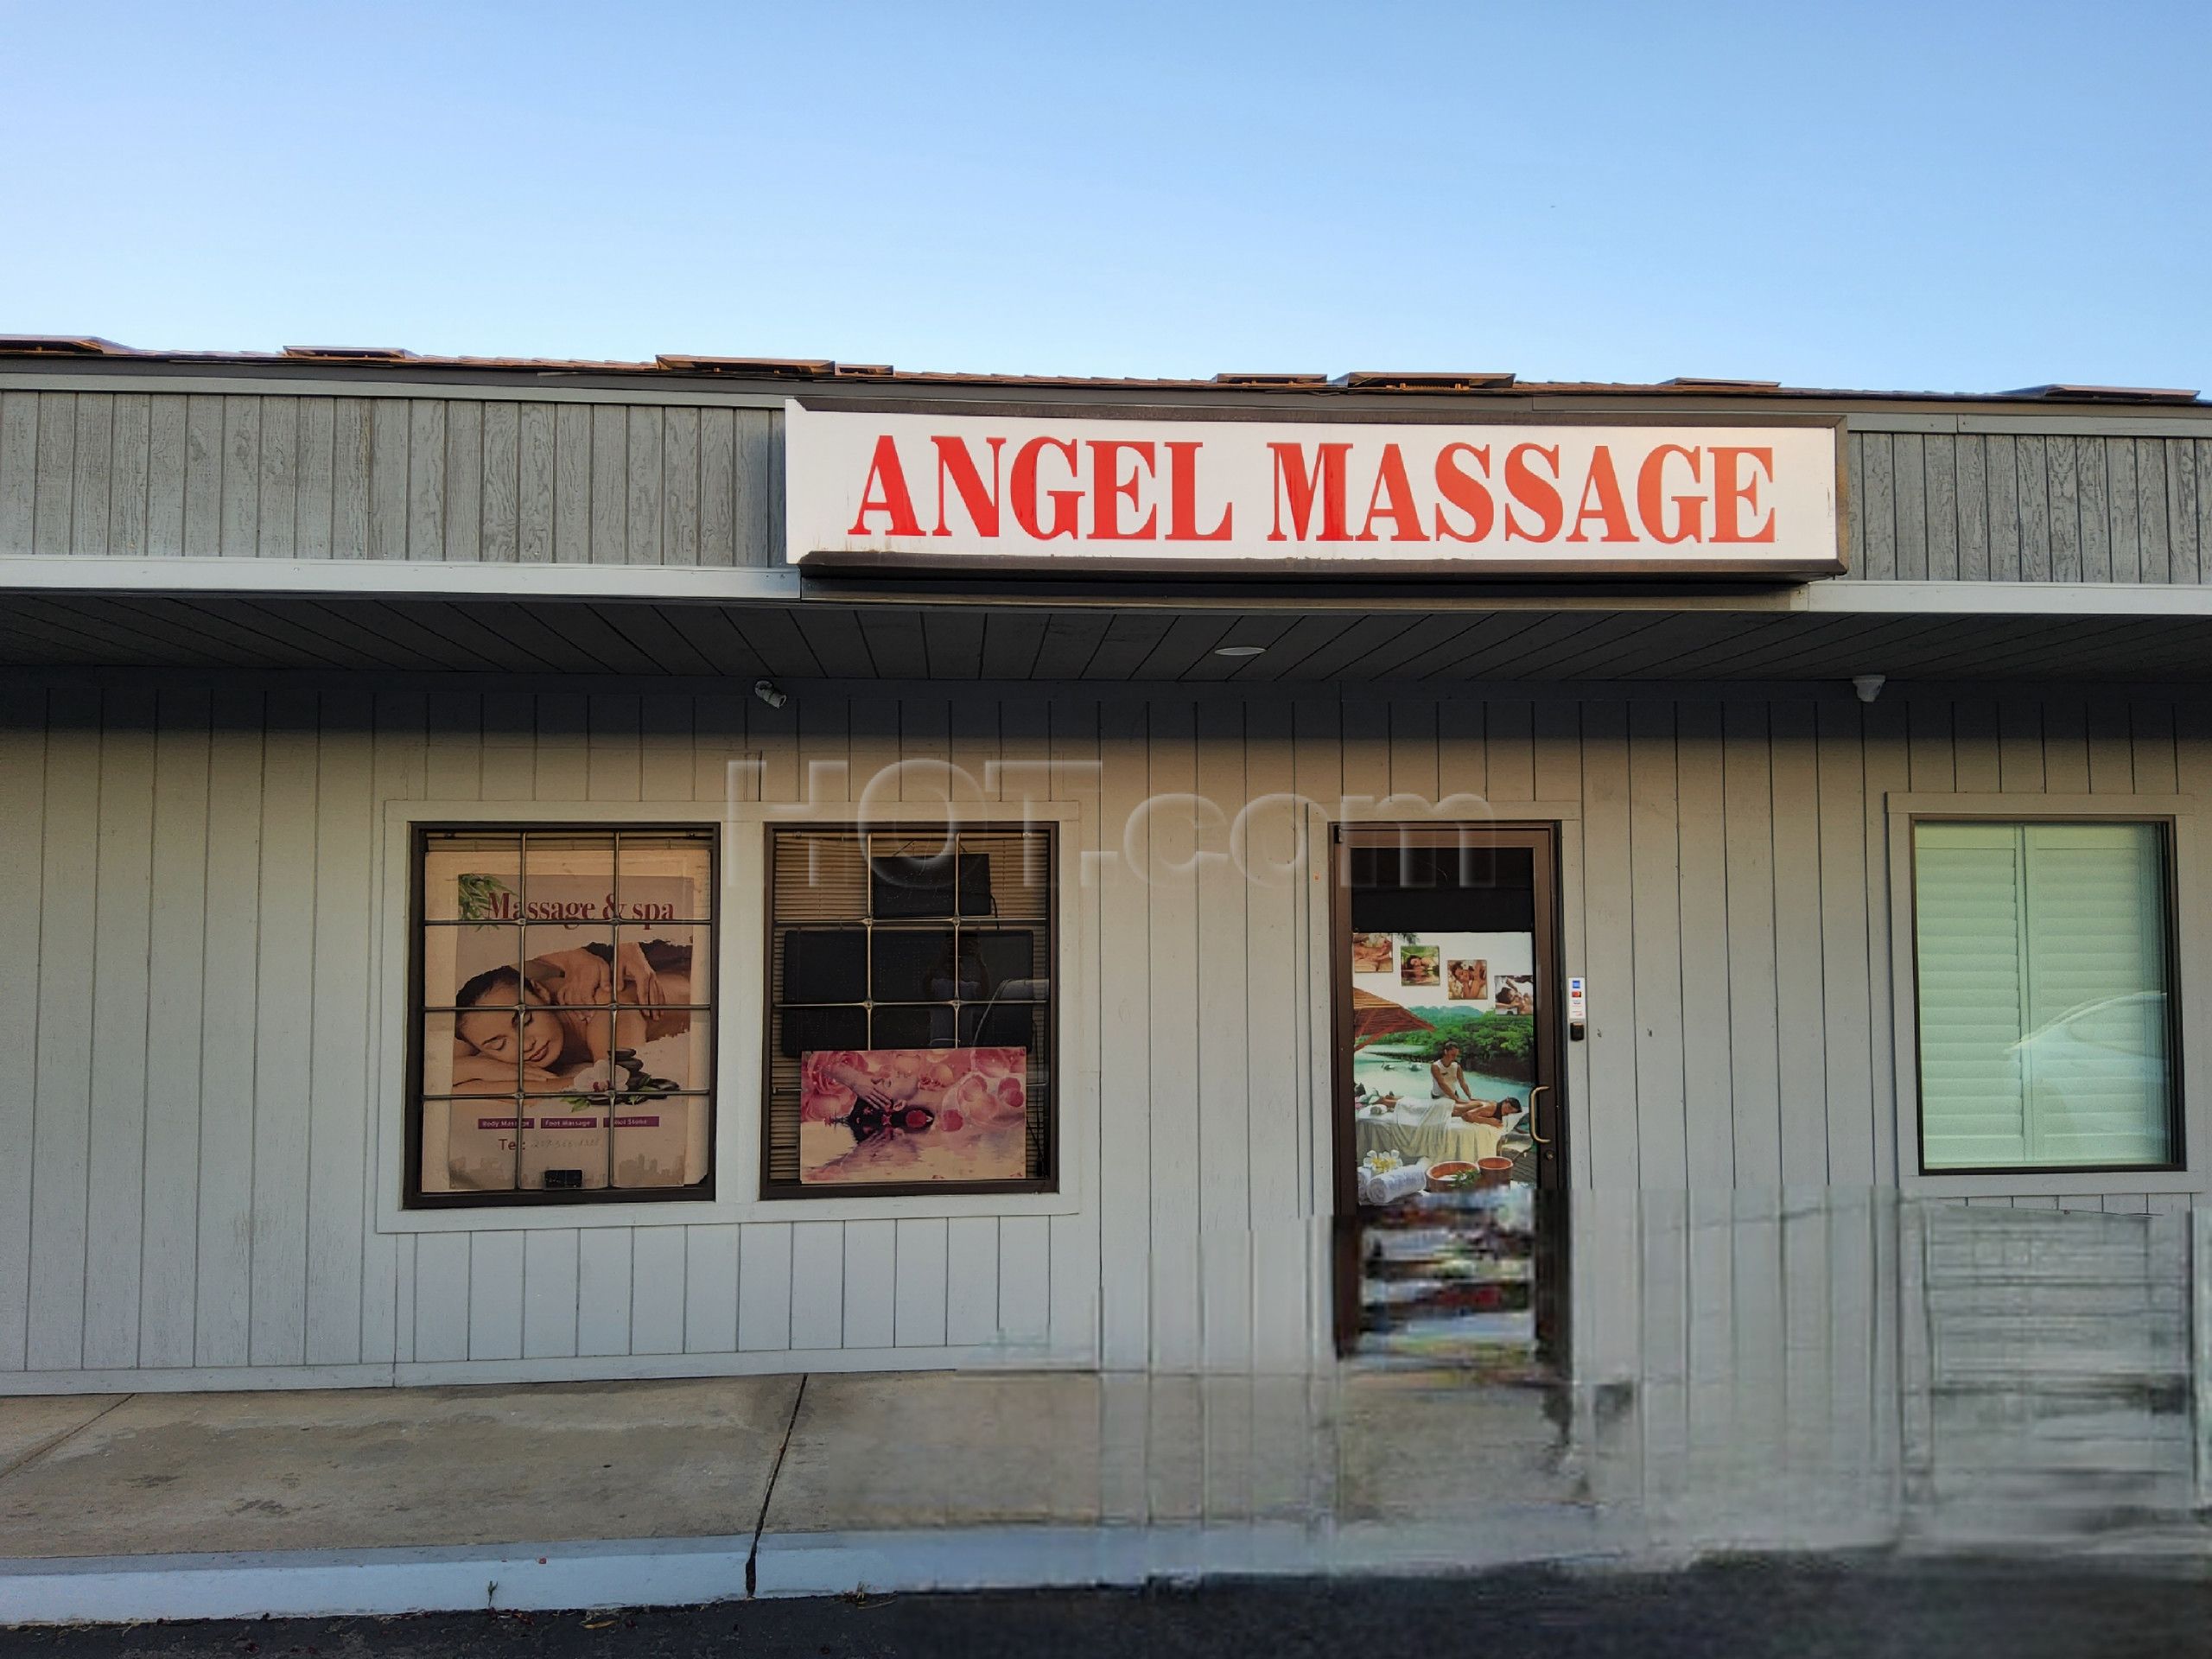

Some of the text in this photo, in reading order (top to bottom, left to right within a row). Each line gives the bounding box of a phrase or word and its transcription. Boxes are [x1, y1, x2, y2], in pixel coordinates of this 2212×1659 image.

[849, 435, 1774, 543] ANGEL MASSAGE
[488, 892, 674, 931] Massage & spa
[498, 1138, 526, 1151] Te:
